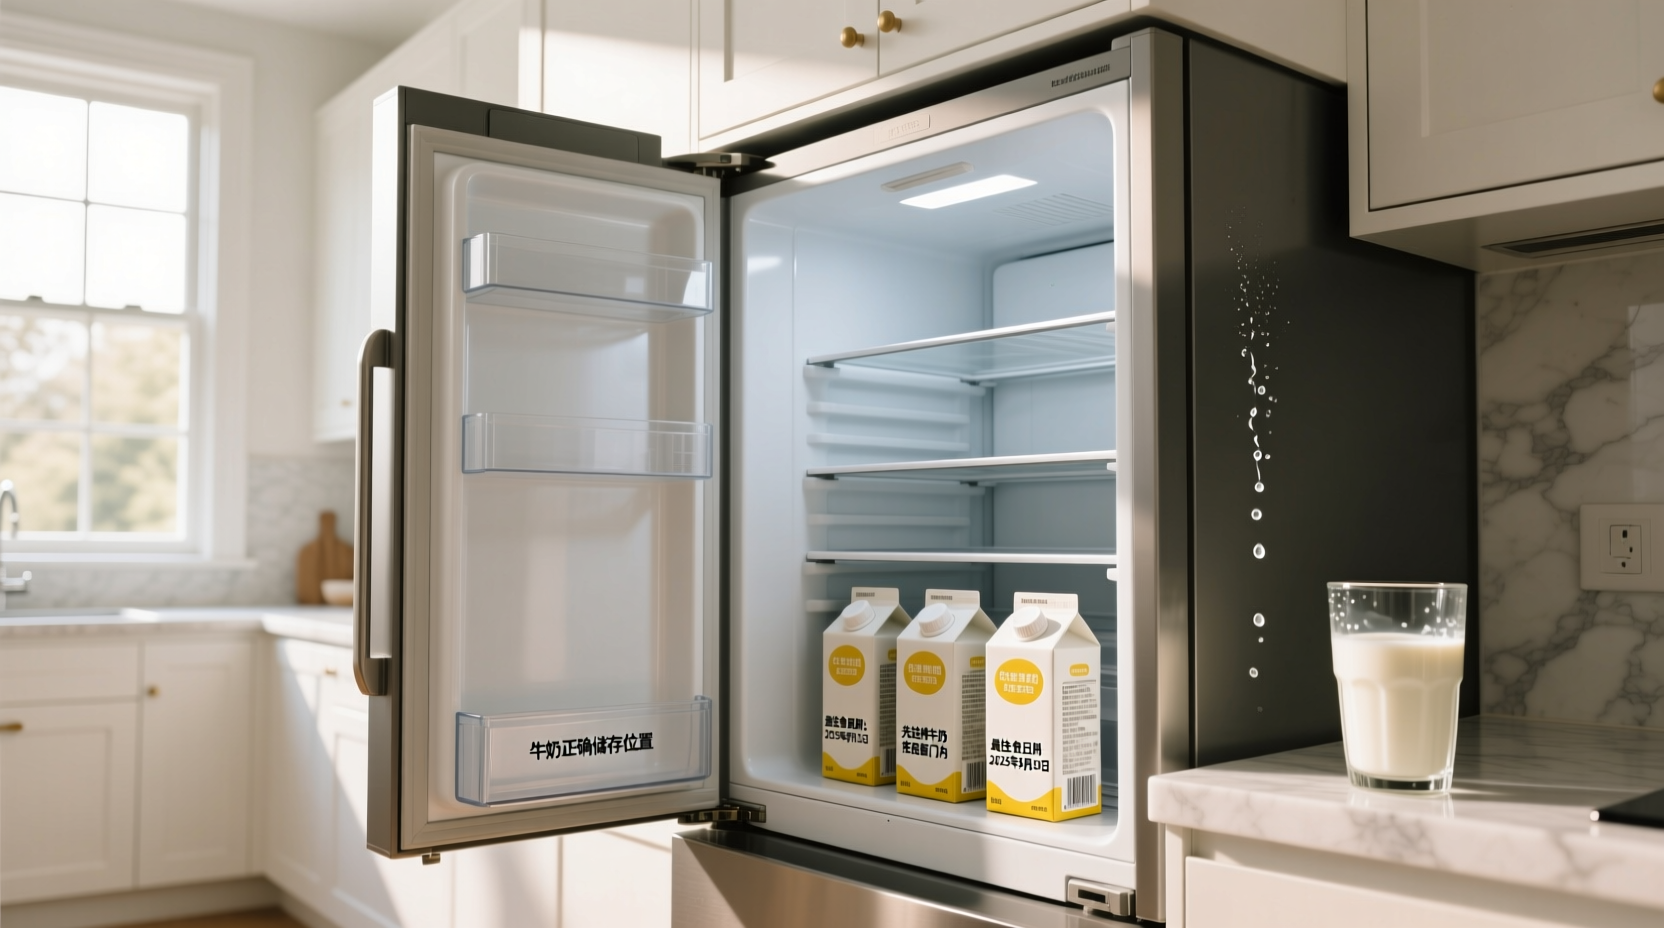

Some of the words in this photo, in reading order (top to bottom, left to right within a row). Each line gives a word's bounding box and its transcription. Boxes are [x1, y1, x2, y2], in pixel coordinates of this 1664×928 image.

[529, 732, 654, 760] 牛奶正确储存位置
